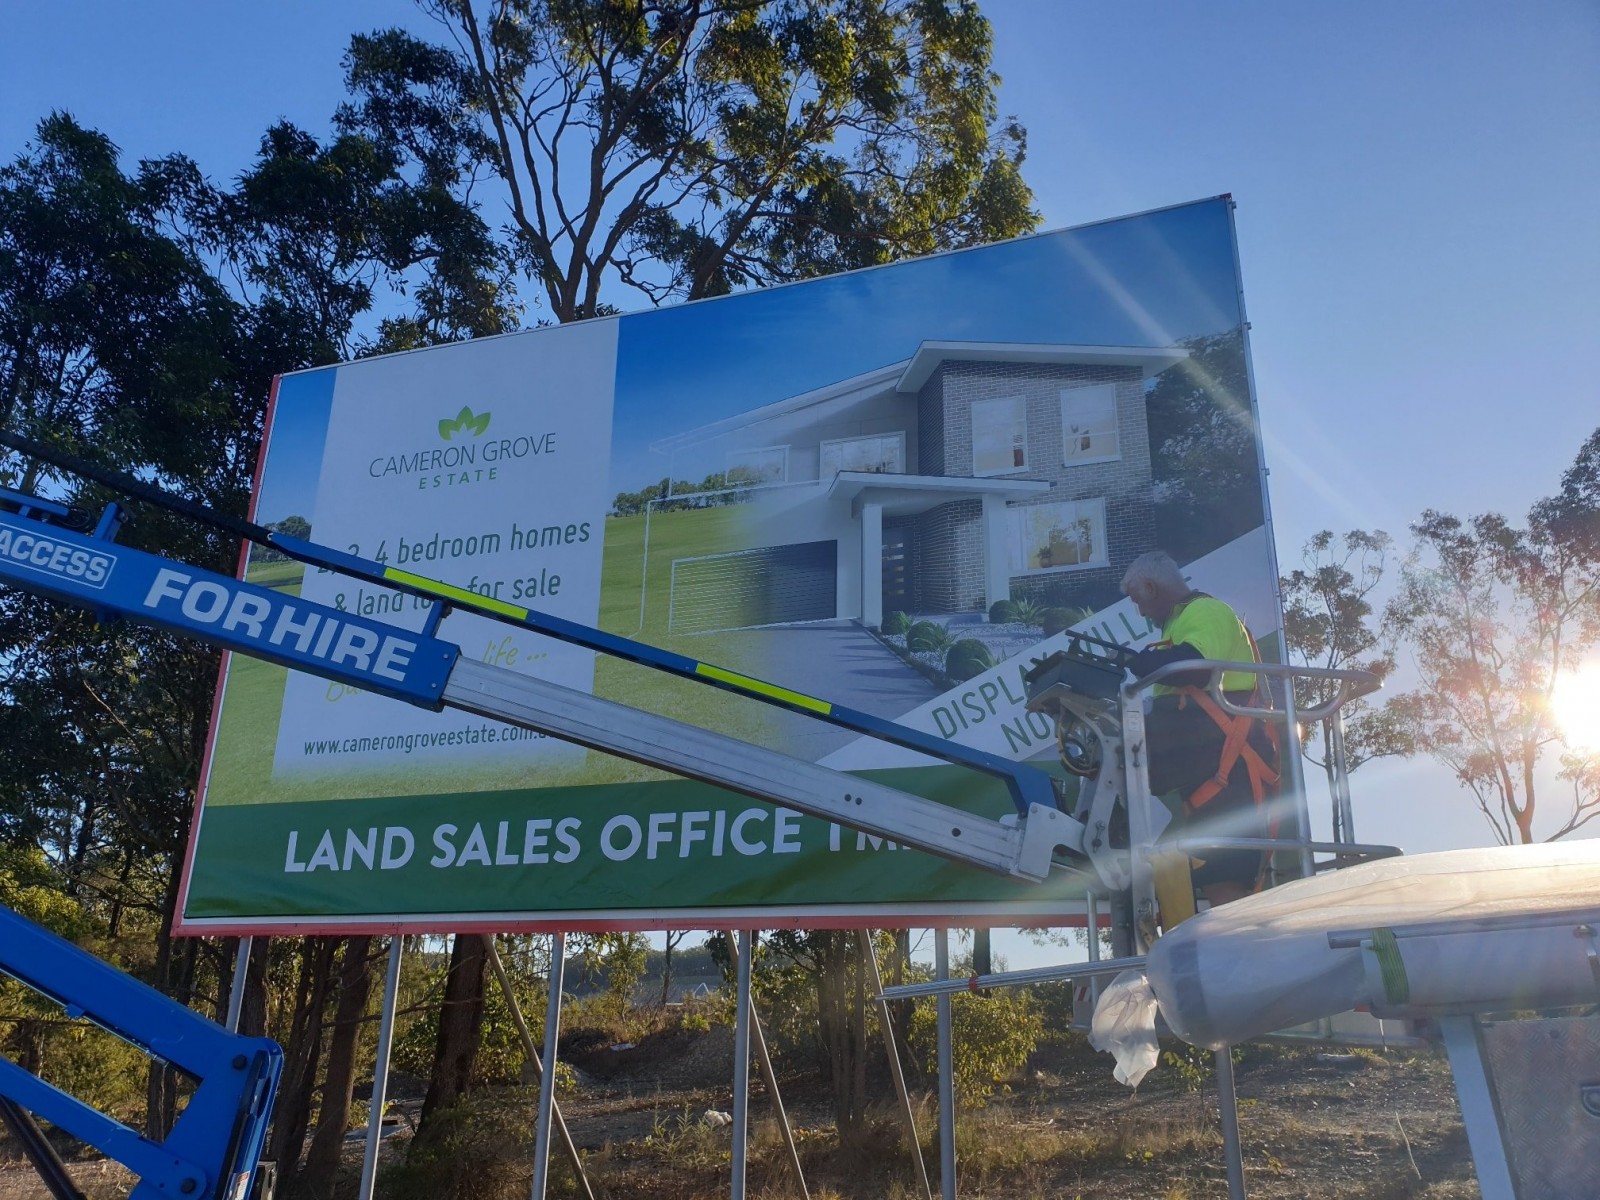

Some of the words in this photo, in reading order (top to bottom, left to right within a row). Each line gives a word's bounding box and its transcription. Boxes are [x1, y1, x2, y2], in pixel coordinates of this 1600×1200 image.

[369, 446, 475, 478] CAMERON
[482, 432, 557, 463] GROVE
[418, 467, 498, 490] ESTATE
[0, 529, 109, 582] ACCESS
[397, 531, 500, 564] bedroom
[510, 522, 591, 551] homes
[357, 588, 404, 616] land
[467, 575, 504, 600] for
[512, 568, 561, 599] sale
[284, 825, 415, 872] LAND
[430, 817, 582, 868] SALES
[600, 808, 803, 861] OFFICE
